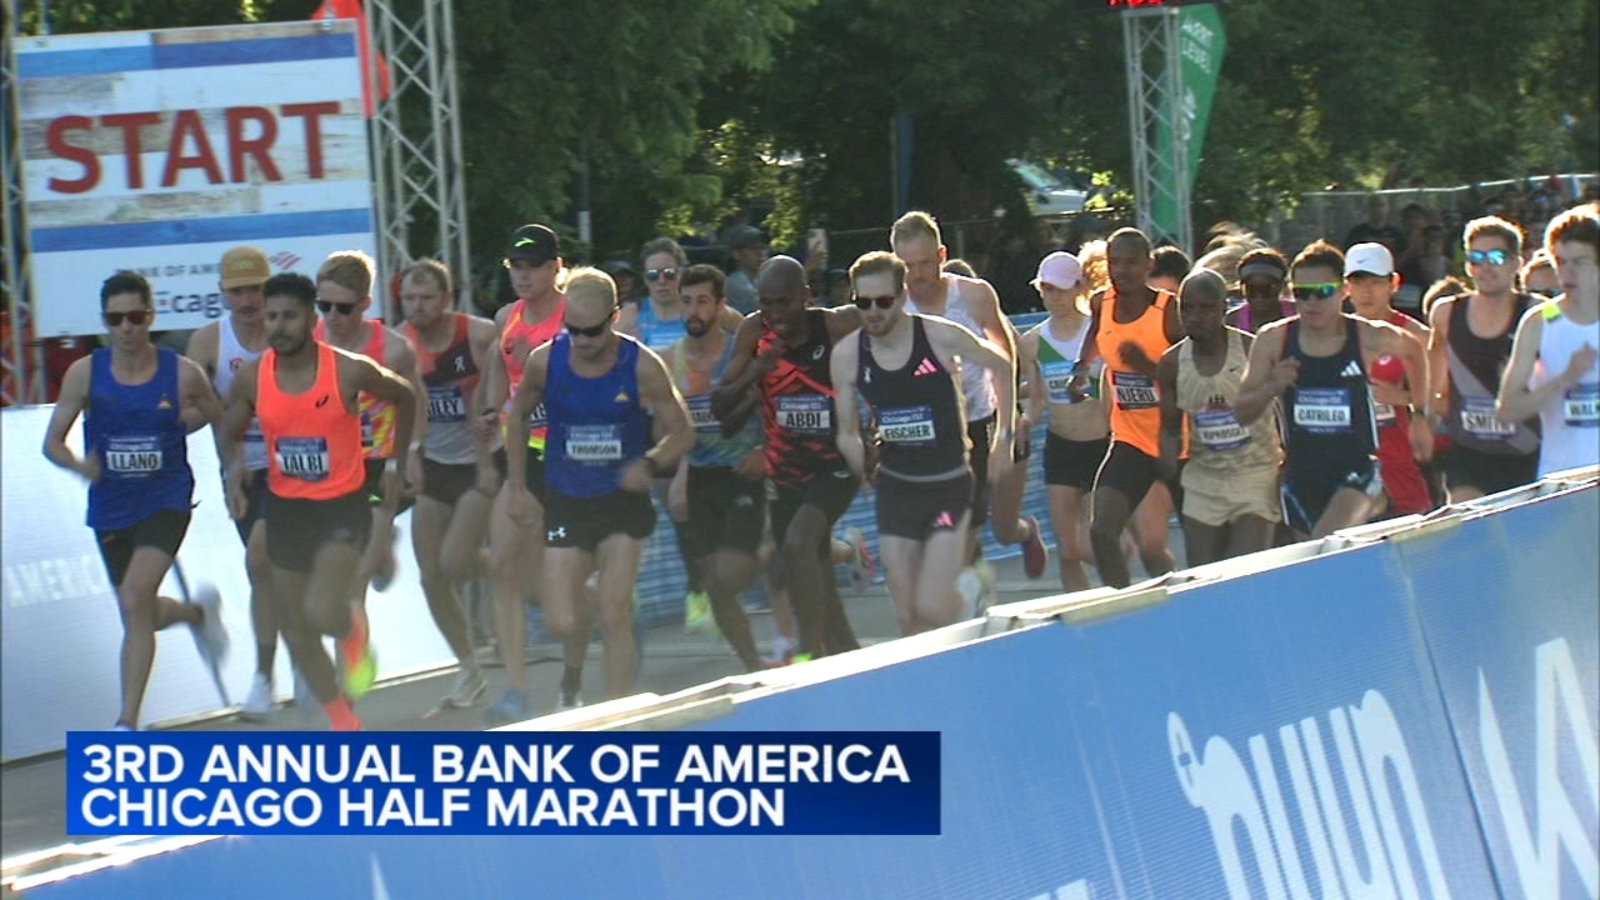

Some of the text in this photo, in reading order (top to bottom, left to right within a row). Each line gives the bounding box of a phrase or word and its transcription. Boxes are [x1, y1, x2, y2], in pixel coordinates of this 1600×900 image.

[46, 101, 341, 194] START
[785, 412, 821, 427] ABDI
[884, 424, 931, 439] FISCHER
[110, 453, 158, 470] LLANO
